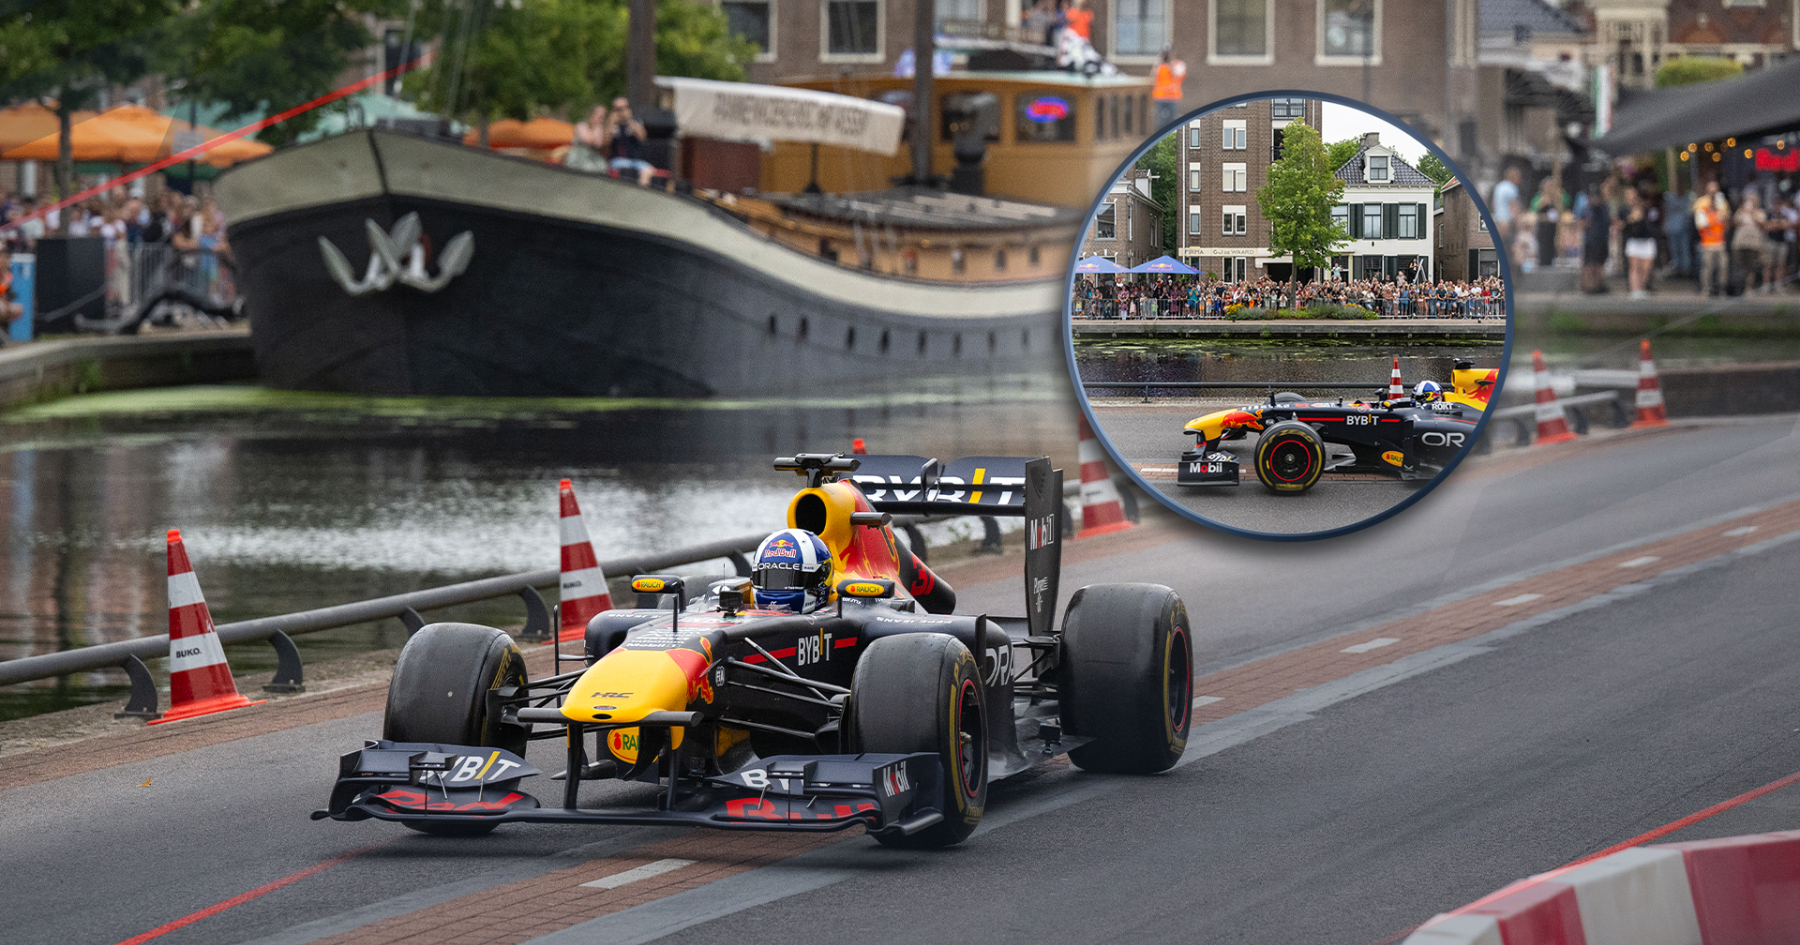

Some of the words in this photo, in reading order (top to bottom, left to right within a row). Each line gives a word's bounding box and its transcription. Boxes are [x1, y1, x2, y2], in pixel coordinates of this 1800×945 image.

[1346, 414, 1379, 426] BYBIT
[1189, 462, 1223, 474] Mobil
[853, 468, 1026, 505] BYBIT
[764, 549, 779, 558] Red
[780, 548, 796, 558] Bull
[759, 562, 800, 571] ORACLE
[856, 585, 880, 593] RAUCH
[798, 628, 832, 666] BYBIT
[883, 761, 910, 797] Mobil
